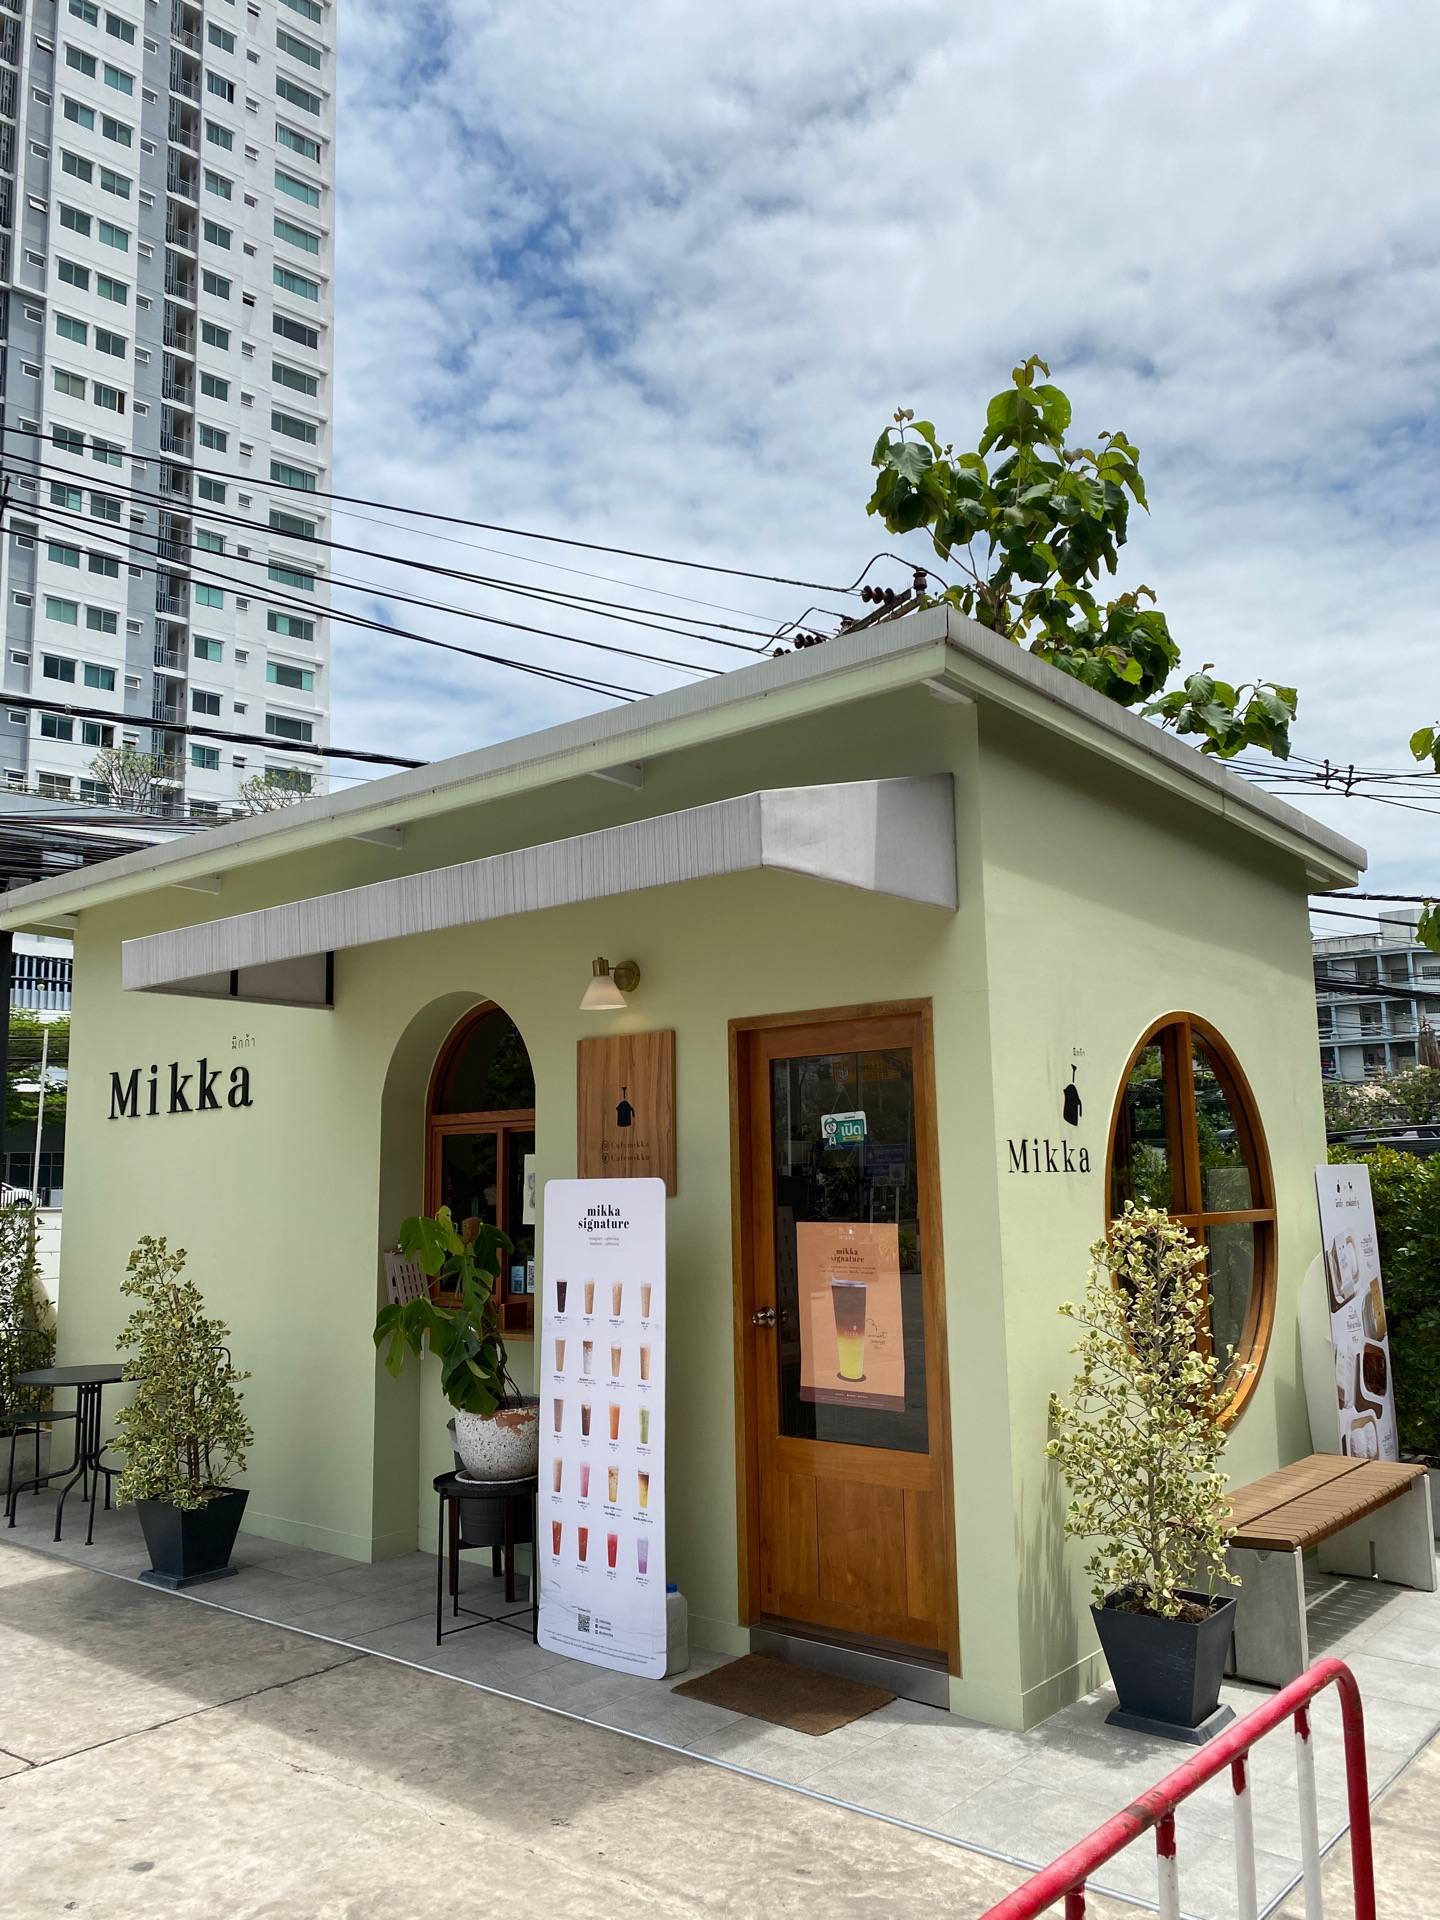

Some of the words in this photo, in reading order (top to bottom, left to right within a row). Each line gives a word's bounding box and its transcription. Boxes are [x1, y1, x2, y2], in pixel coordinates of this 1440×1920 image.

[107, 1057, 254, 1120] Mikka
[841, 1123, 862, 1137] เปิด
[1007, 1138, 1091, 1173] Mikka
[587, 1204, 621, 1217] mikka
[578, 1217, 630, 1232] signature
[835, 1247, 858, 1255] mikka
